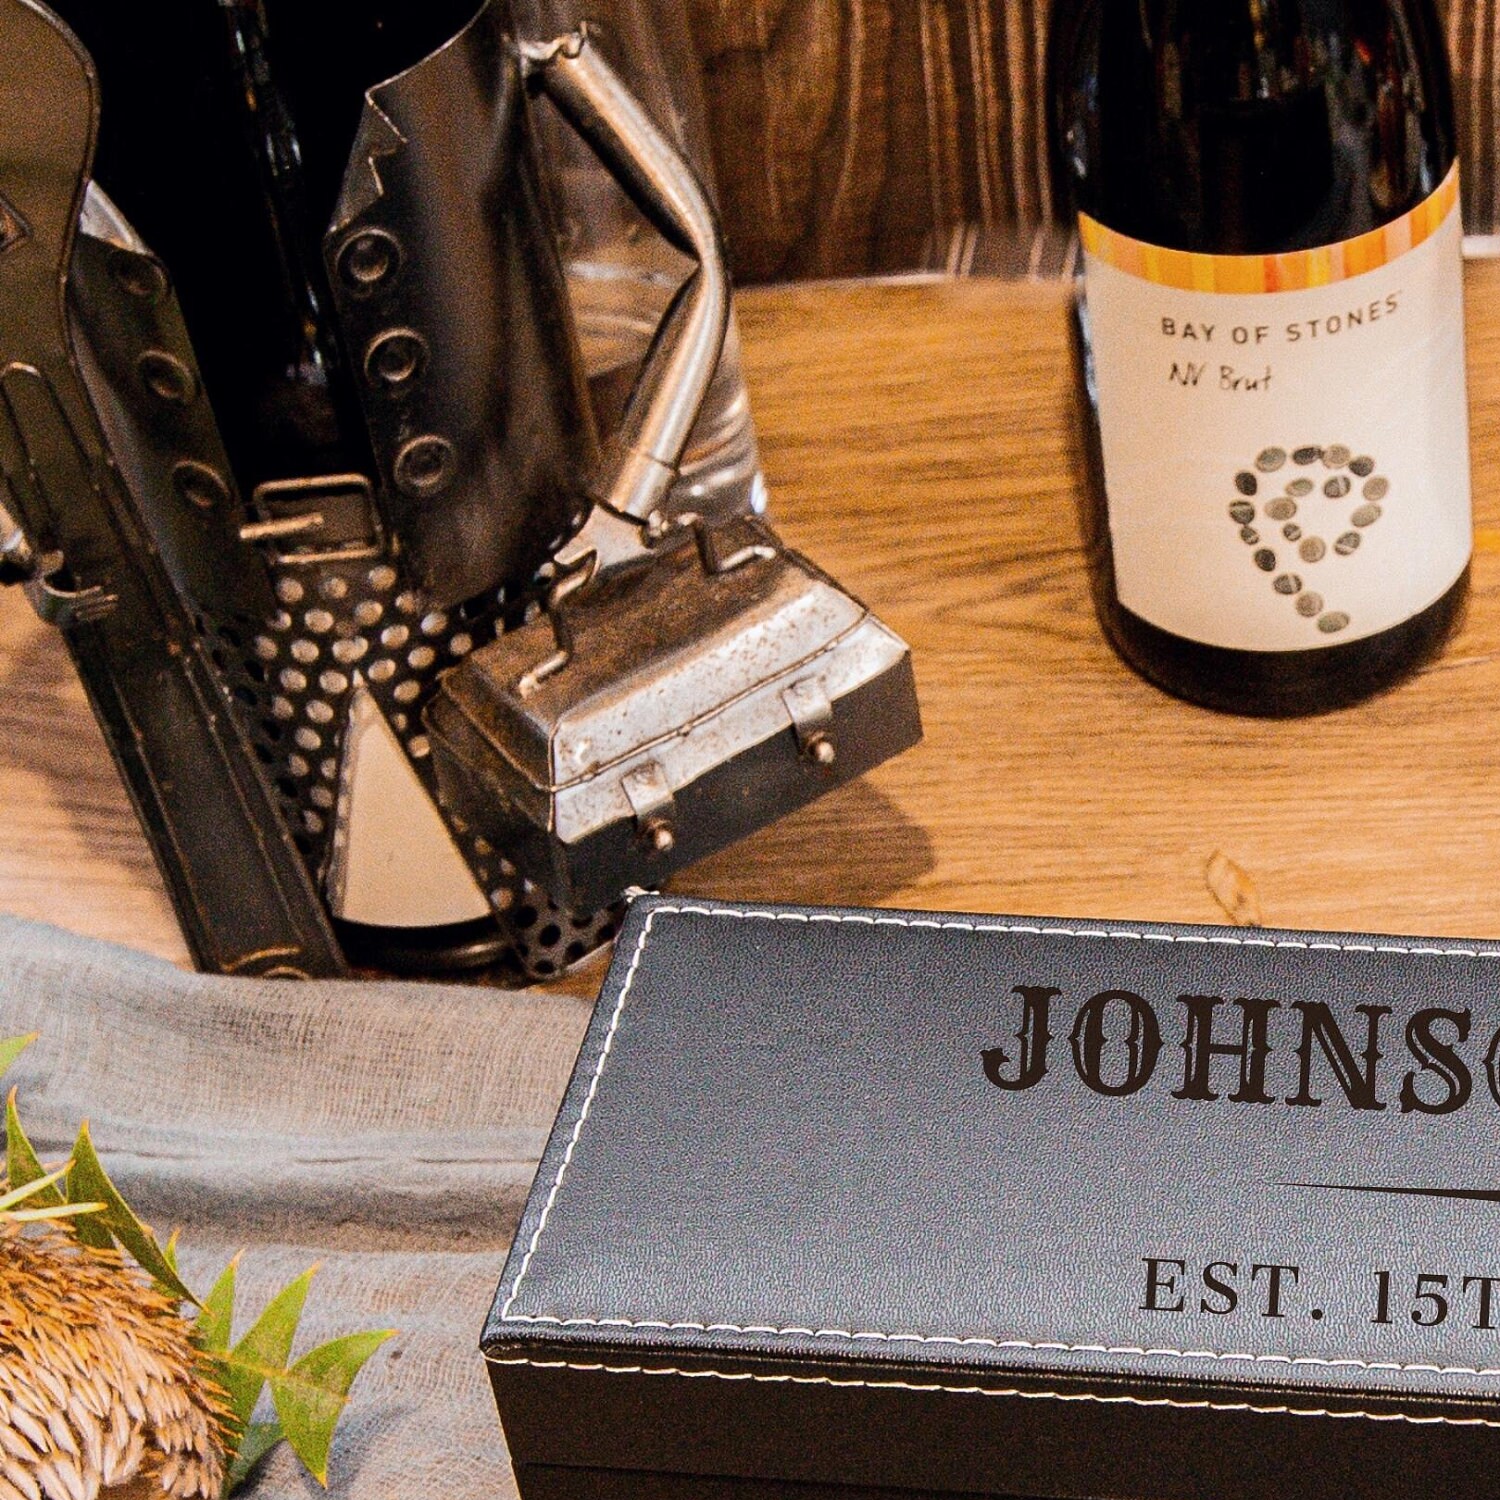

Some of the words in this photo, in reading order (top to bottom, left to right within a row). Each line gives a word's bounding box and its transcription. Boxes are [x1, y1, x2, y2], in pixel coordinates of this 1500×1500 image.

[1160, 316, 1215, 342] BAY
[1231, 325, 1270, 345] OF
[1286, 292, 1400, 343] STONES
[1218, 363, 1273, 392] Brut
[1138, 1256, 1325, 1321] EST.
